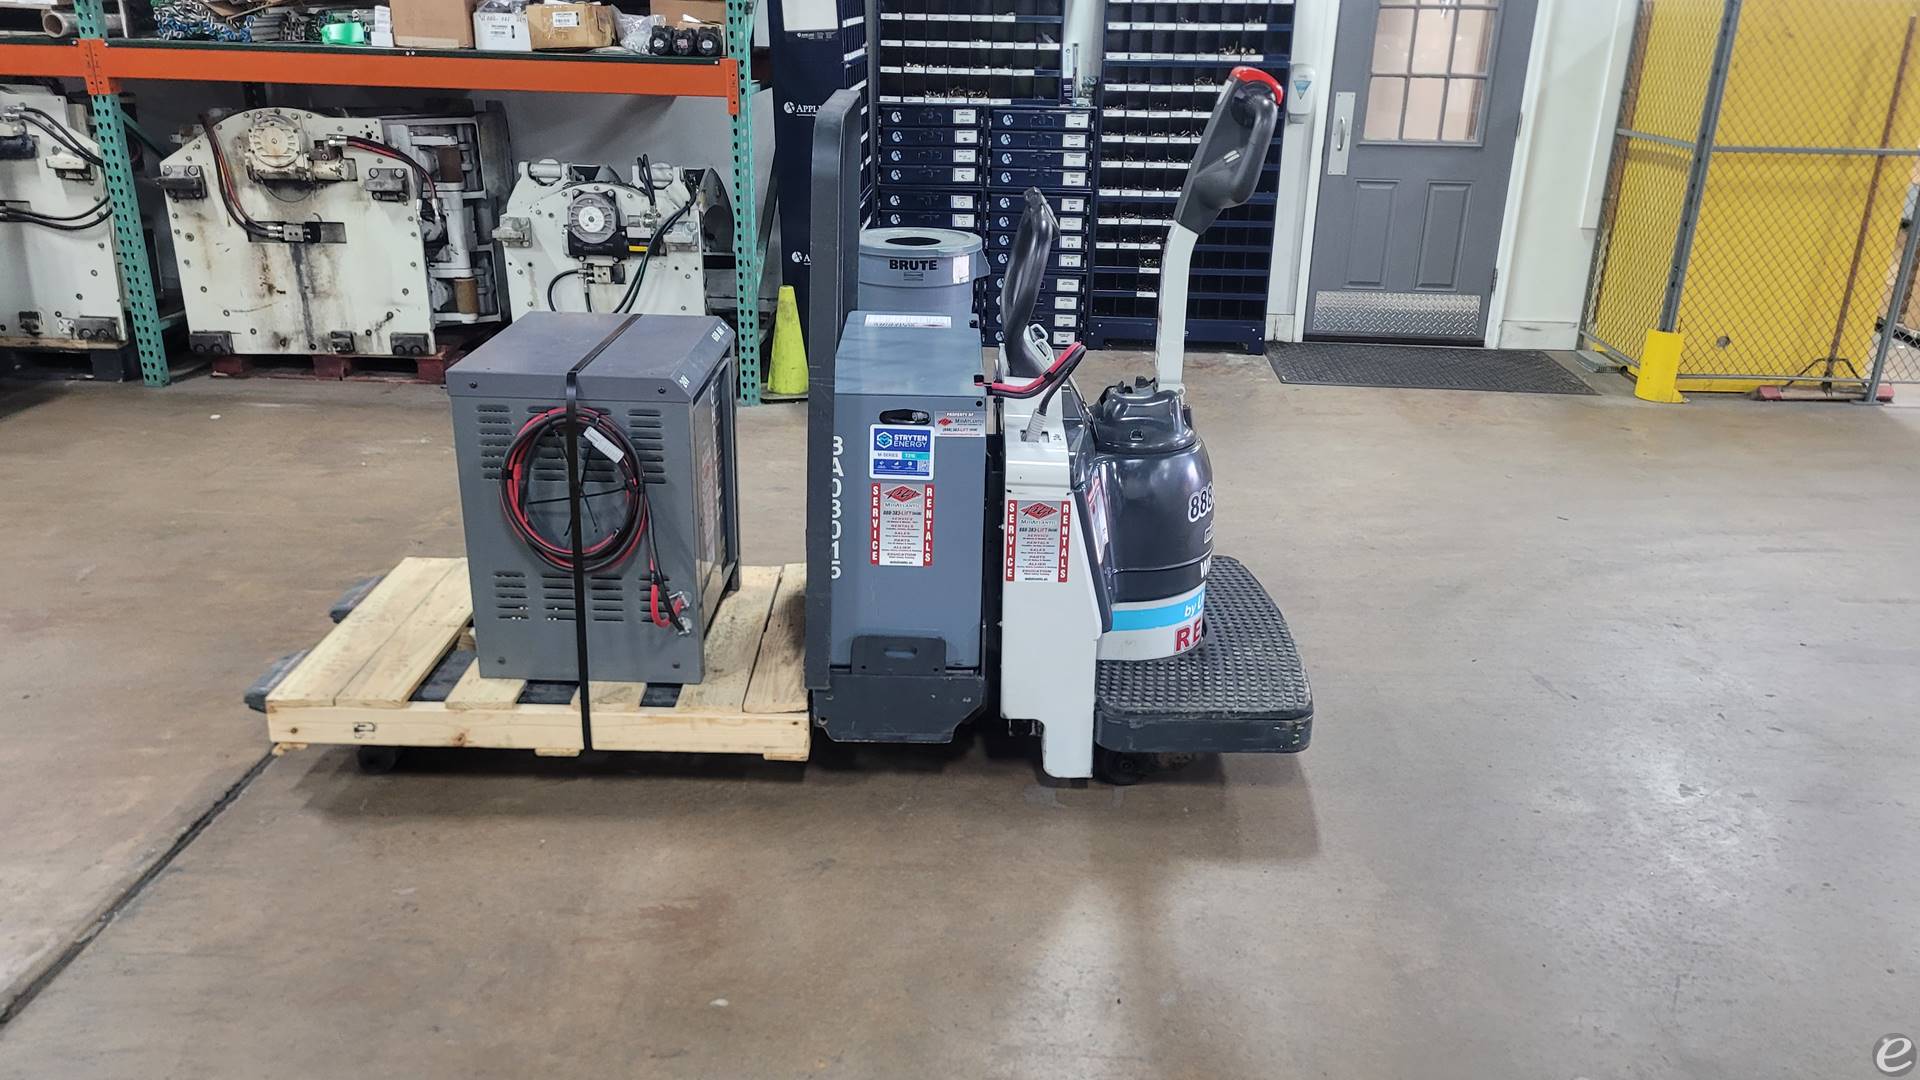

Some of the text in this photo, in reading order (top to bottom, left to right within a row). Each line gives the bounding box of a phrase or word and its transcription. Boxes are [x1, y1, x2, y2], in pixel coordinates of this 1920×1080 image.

[889, 259, 938, 271] BRUTE
[893, 440, 927, 448] ENERGY
[1189, 483, 1214, 522] 888
[925, 487, 933, 562] RENTALS
[1007, 502, 1015, 578] SERVICE
[1060, 504, 1069, 578] RENTALS
[1184, 603, 1197, 617] by
